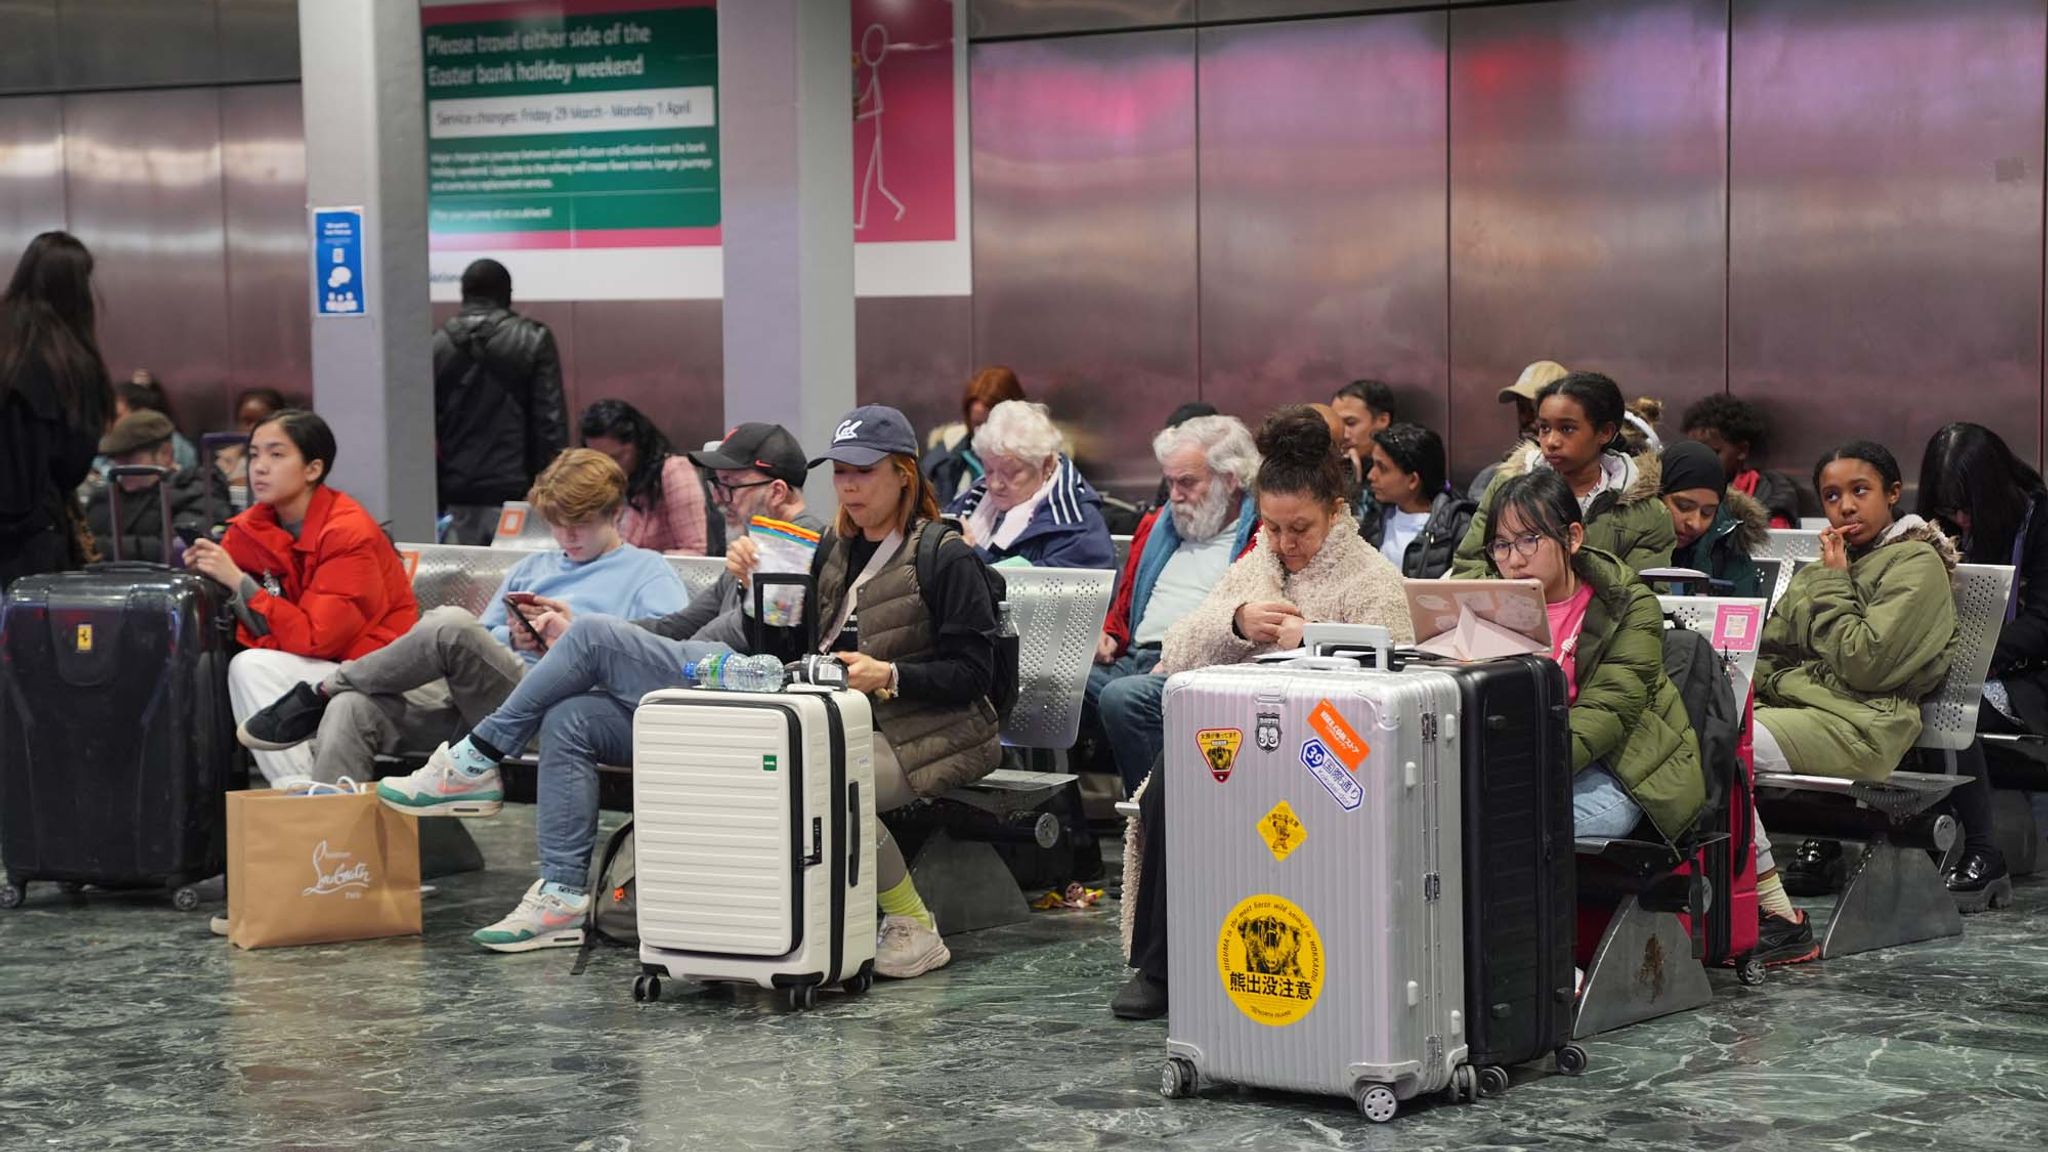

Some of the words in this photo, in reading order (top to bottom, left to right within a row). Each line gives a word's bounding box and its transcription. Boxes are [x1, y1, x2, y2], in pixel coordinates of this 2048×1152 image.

[427, 35, 475, 54] Please
[477, 33, 519, 52] travel
[522, 30, 566, 49] either
[569, 27, 600, 47] side
[603, 24, 622, 43] of
[624, 23, 651, 43] the
[428, 65, 474, 86] Easter
[477, 63, 513, 83] bank
[516, 58, 572, 85] holiday
[575, 54, 645, 78] weekend
[570, 106, 602, 120] March
[611, 103, 655, 119] Monday
[665, 101, 692, 117] April
[833, 419, 863, 443] Cal
[1306, 746, 1323, 765] 39
[1322, 758, 1360, 800] 国際通り
[1229, 971, 1313, 1001] 熊出没注意
